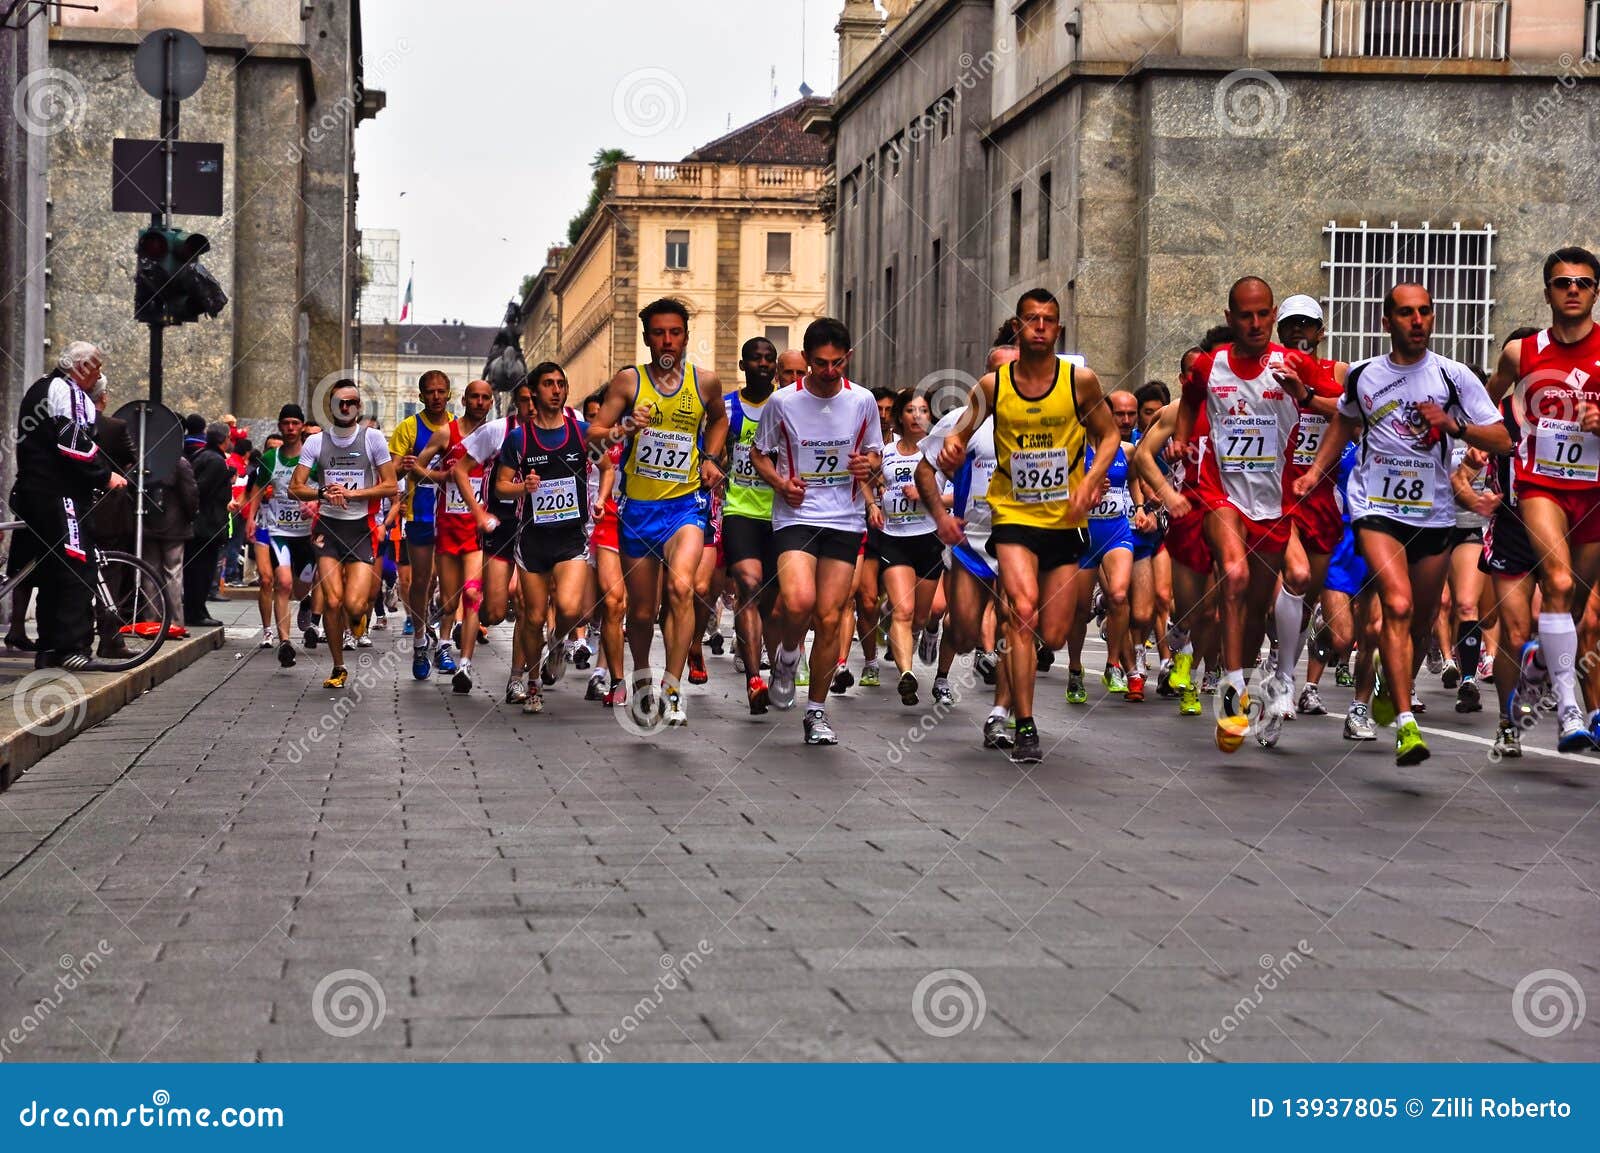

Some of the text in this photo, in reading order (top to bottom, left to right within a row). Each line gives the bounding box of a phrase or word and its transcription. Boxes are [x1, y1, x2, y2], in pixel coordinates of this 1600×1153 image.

[1544, 389, 1600, 400] SPORTCITY
[650, 431, 675, 441] UniCredit
[1226, 437, 1265, 456] 771
[1555, 442, 1583, 464] 10
[639, 446, 689, 468] 2137
[815, 456, 839, 472] 79
[1381, 457, 1412, 467] UniCredit
[1016, 467, 1065, 488] 3965
[1382, 477, 1425, 500] 168
[536, 493, 575, 511] 2203
